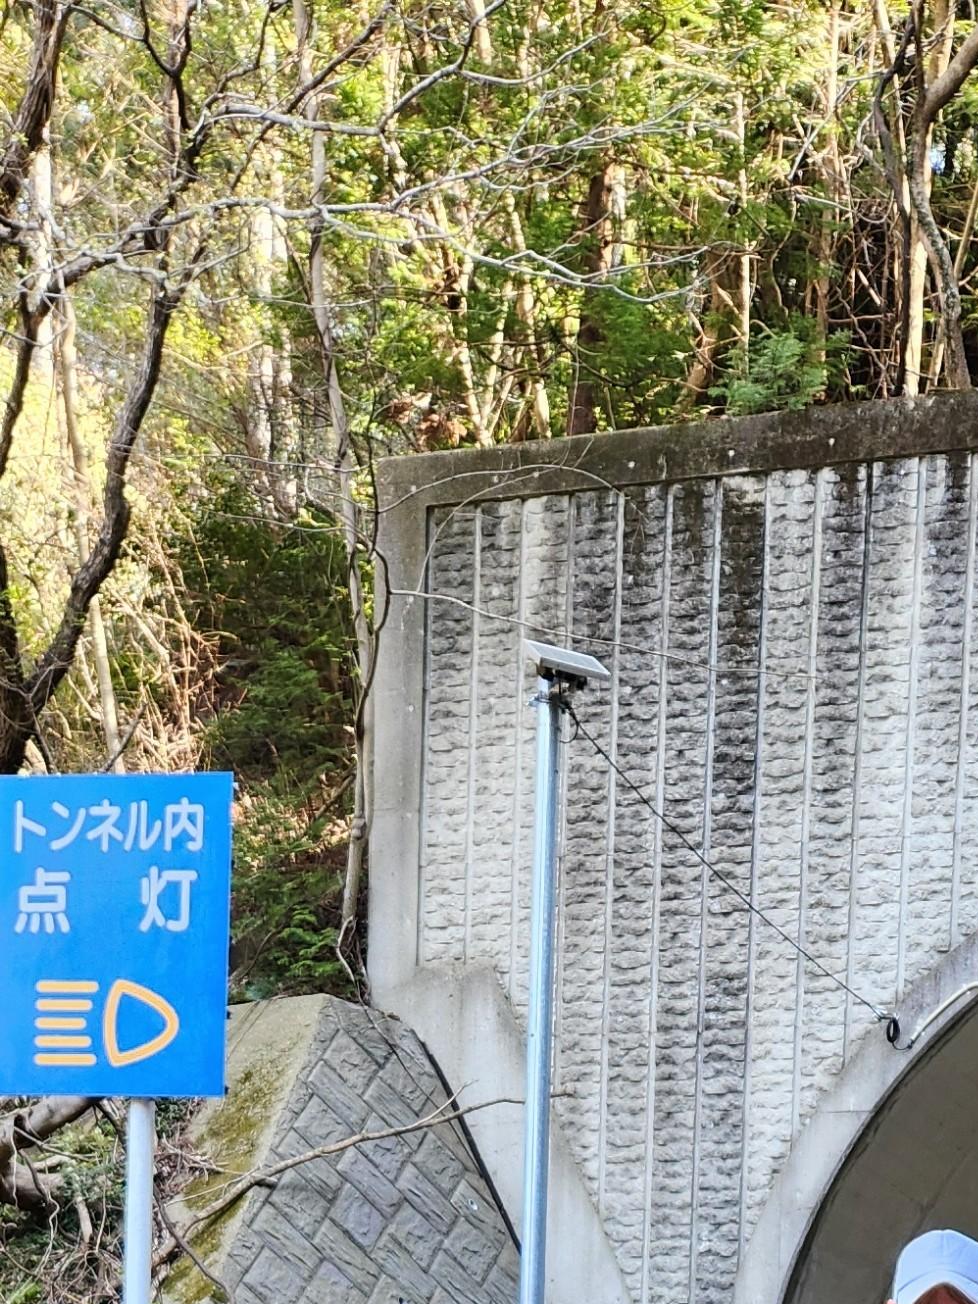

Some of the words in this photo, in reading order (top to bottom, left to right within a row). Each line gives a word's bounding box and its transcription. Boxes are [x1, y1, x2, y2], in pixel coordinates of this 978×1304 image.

[14, 797, 205, 853] トンネル内
[14, 866, 198, 934] 点灯
